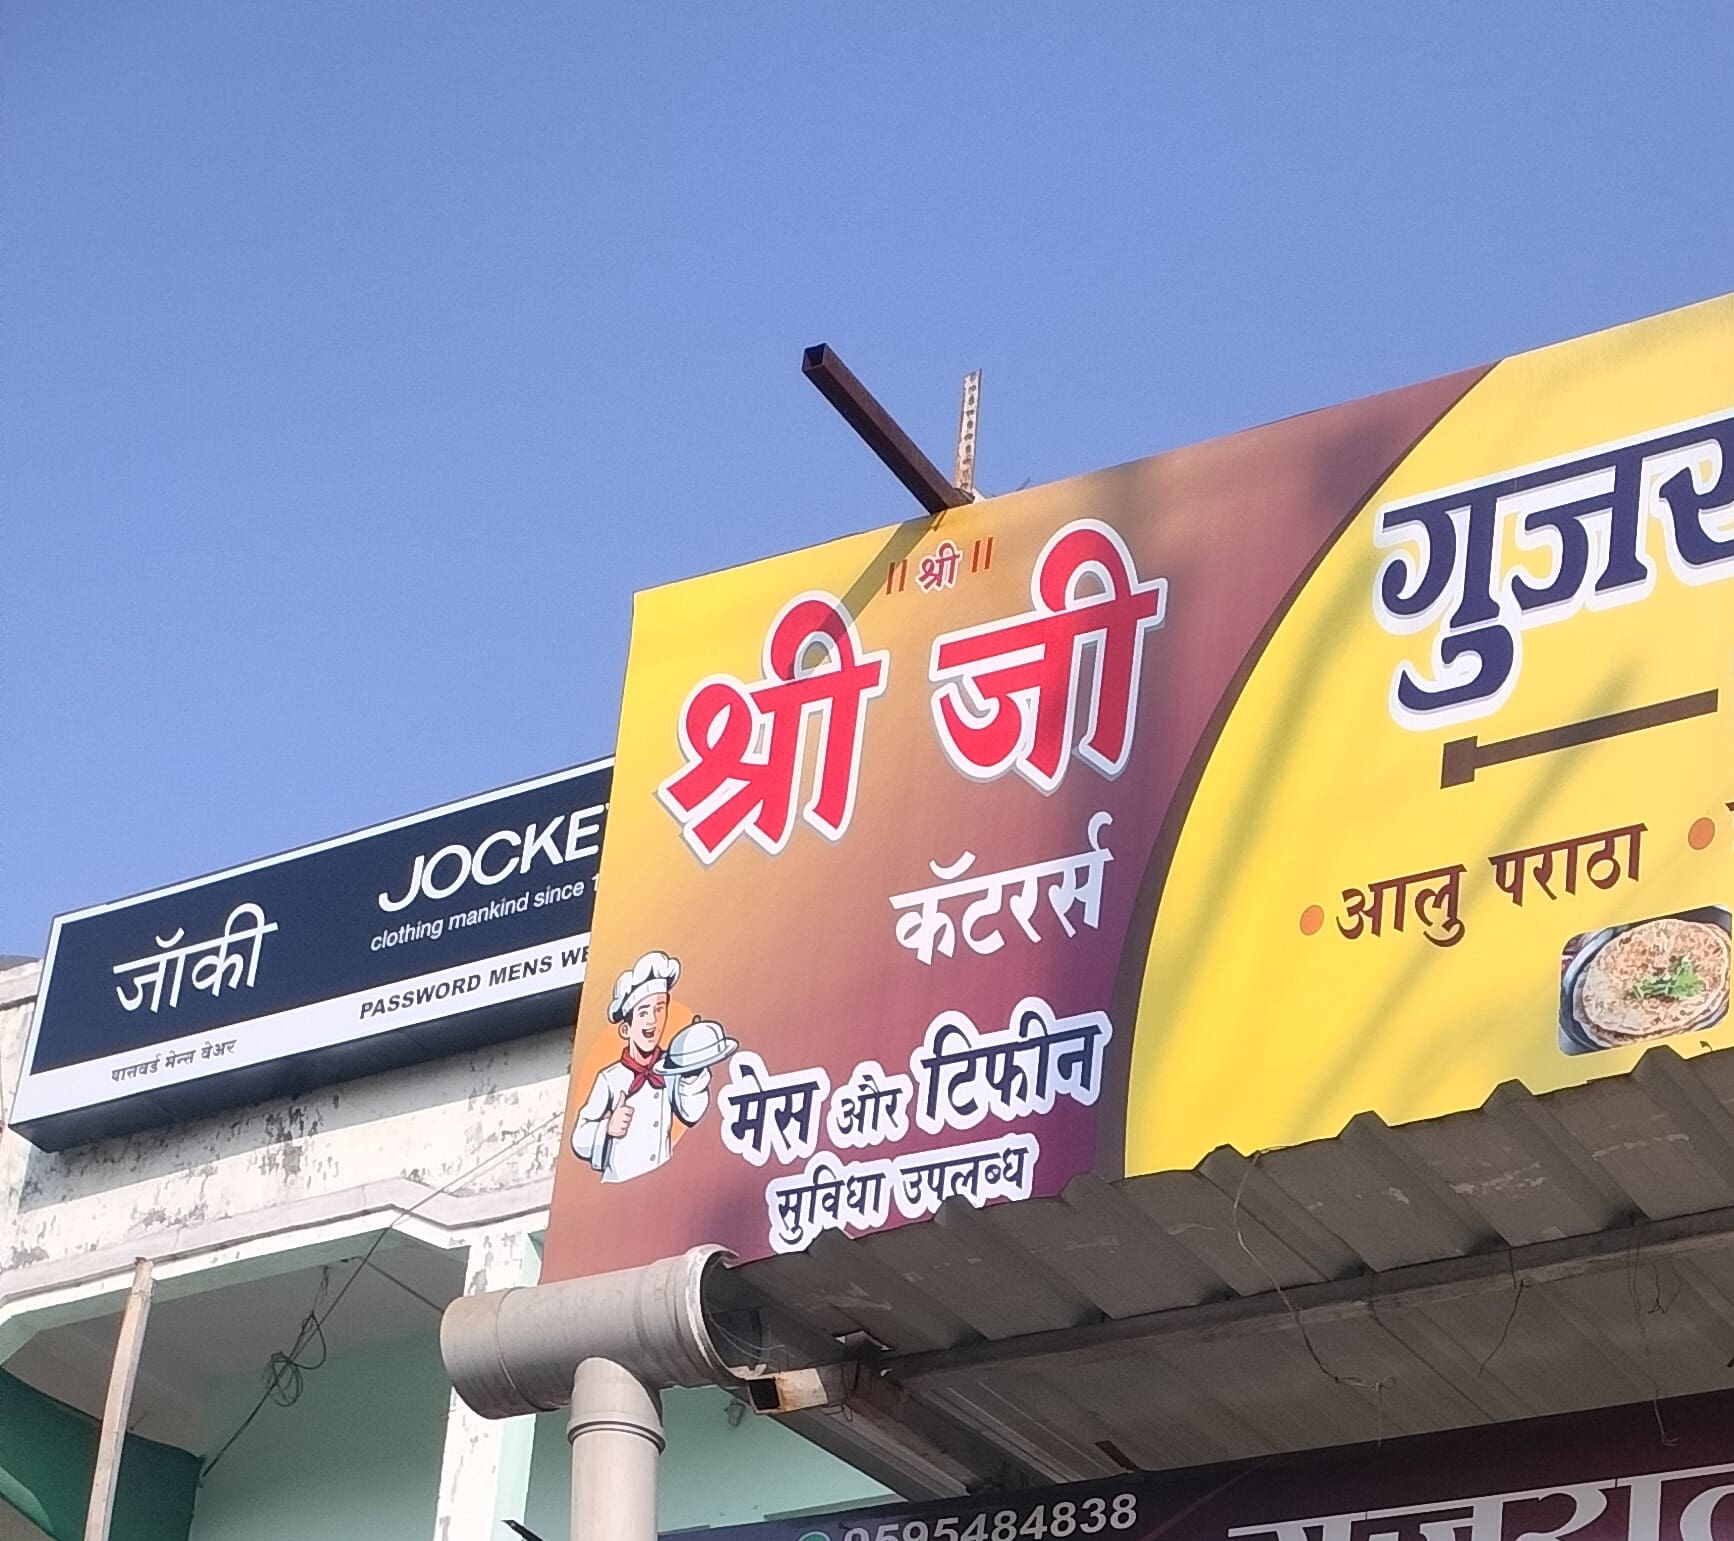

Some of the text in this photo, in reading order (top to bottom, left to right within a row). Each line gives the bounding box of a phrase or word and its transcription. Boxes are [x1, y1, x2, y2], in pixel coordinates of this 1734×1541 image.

[662, 519, 1168, 866] श्री जी
[377, 803, 609, 912] JOCKE
[889, 814, 1113, 967] कॅटरर्स
[1336, 864, 1466, 946] आलु
[1490, 824, 1647, 908] पराठा
[112, 902, 279, 1015] जॉकी
[370, 917, 443, 951] clothing
[448, 893, 529, 930] mankind
[533, 880, 585, 908] since
[360, 974, 481, 1020] PASSWORD
[488, 955, 553, 988] MENS
[724, 1010, 1104, 1158] मेस और टिफीन
[774, 1146, 1029, 1246] सुविधा उपलब्ध
